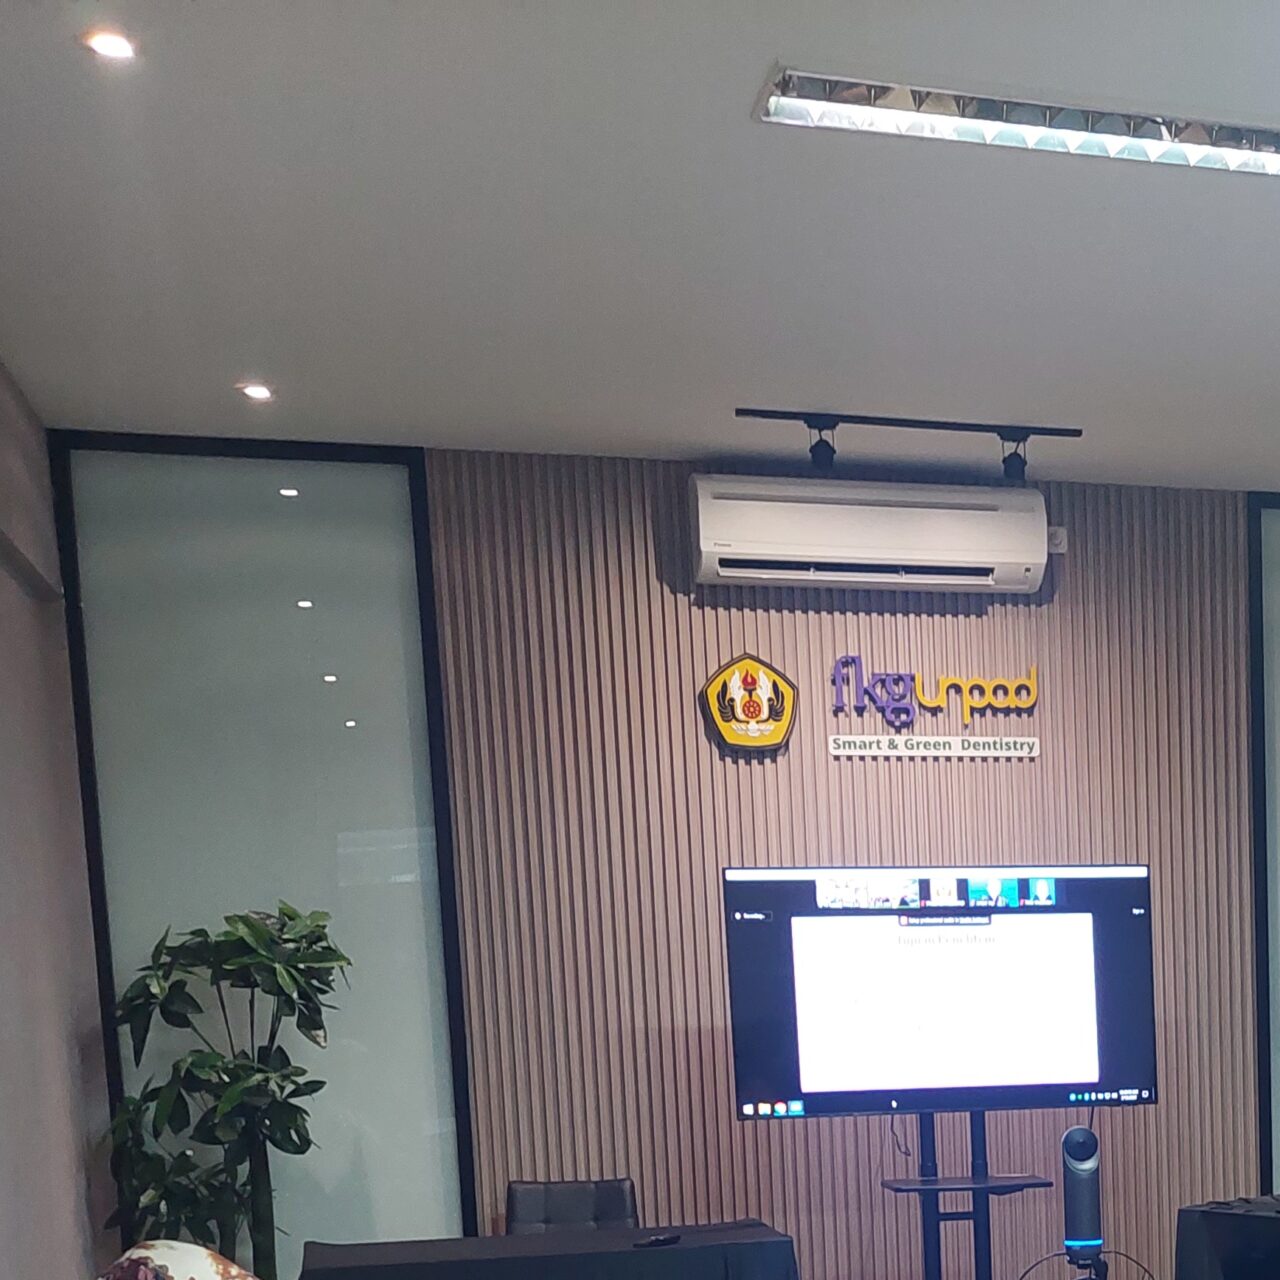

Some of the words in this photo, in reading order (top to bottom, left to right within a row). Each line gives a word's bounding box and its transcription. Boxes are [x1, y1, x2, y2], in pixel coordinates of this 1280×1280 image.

[832, 738, 883, 751] Smart
[888, 738, 899, 751] &
[904, 738, 951, 751] Green
[961, 738, 1036, 755] Dentistry
